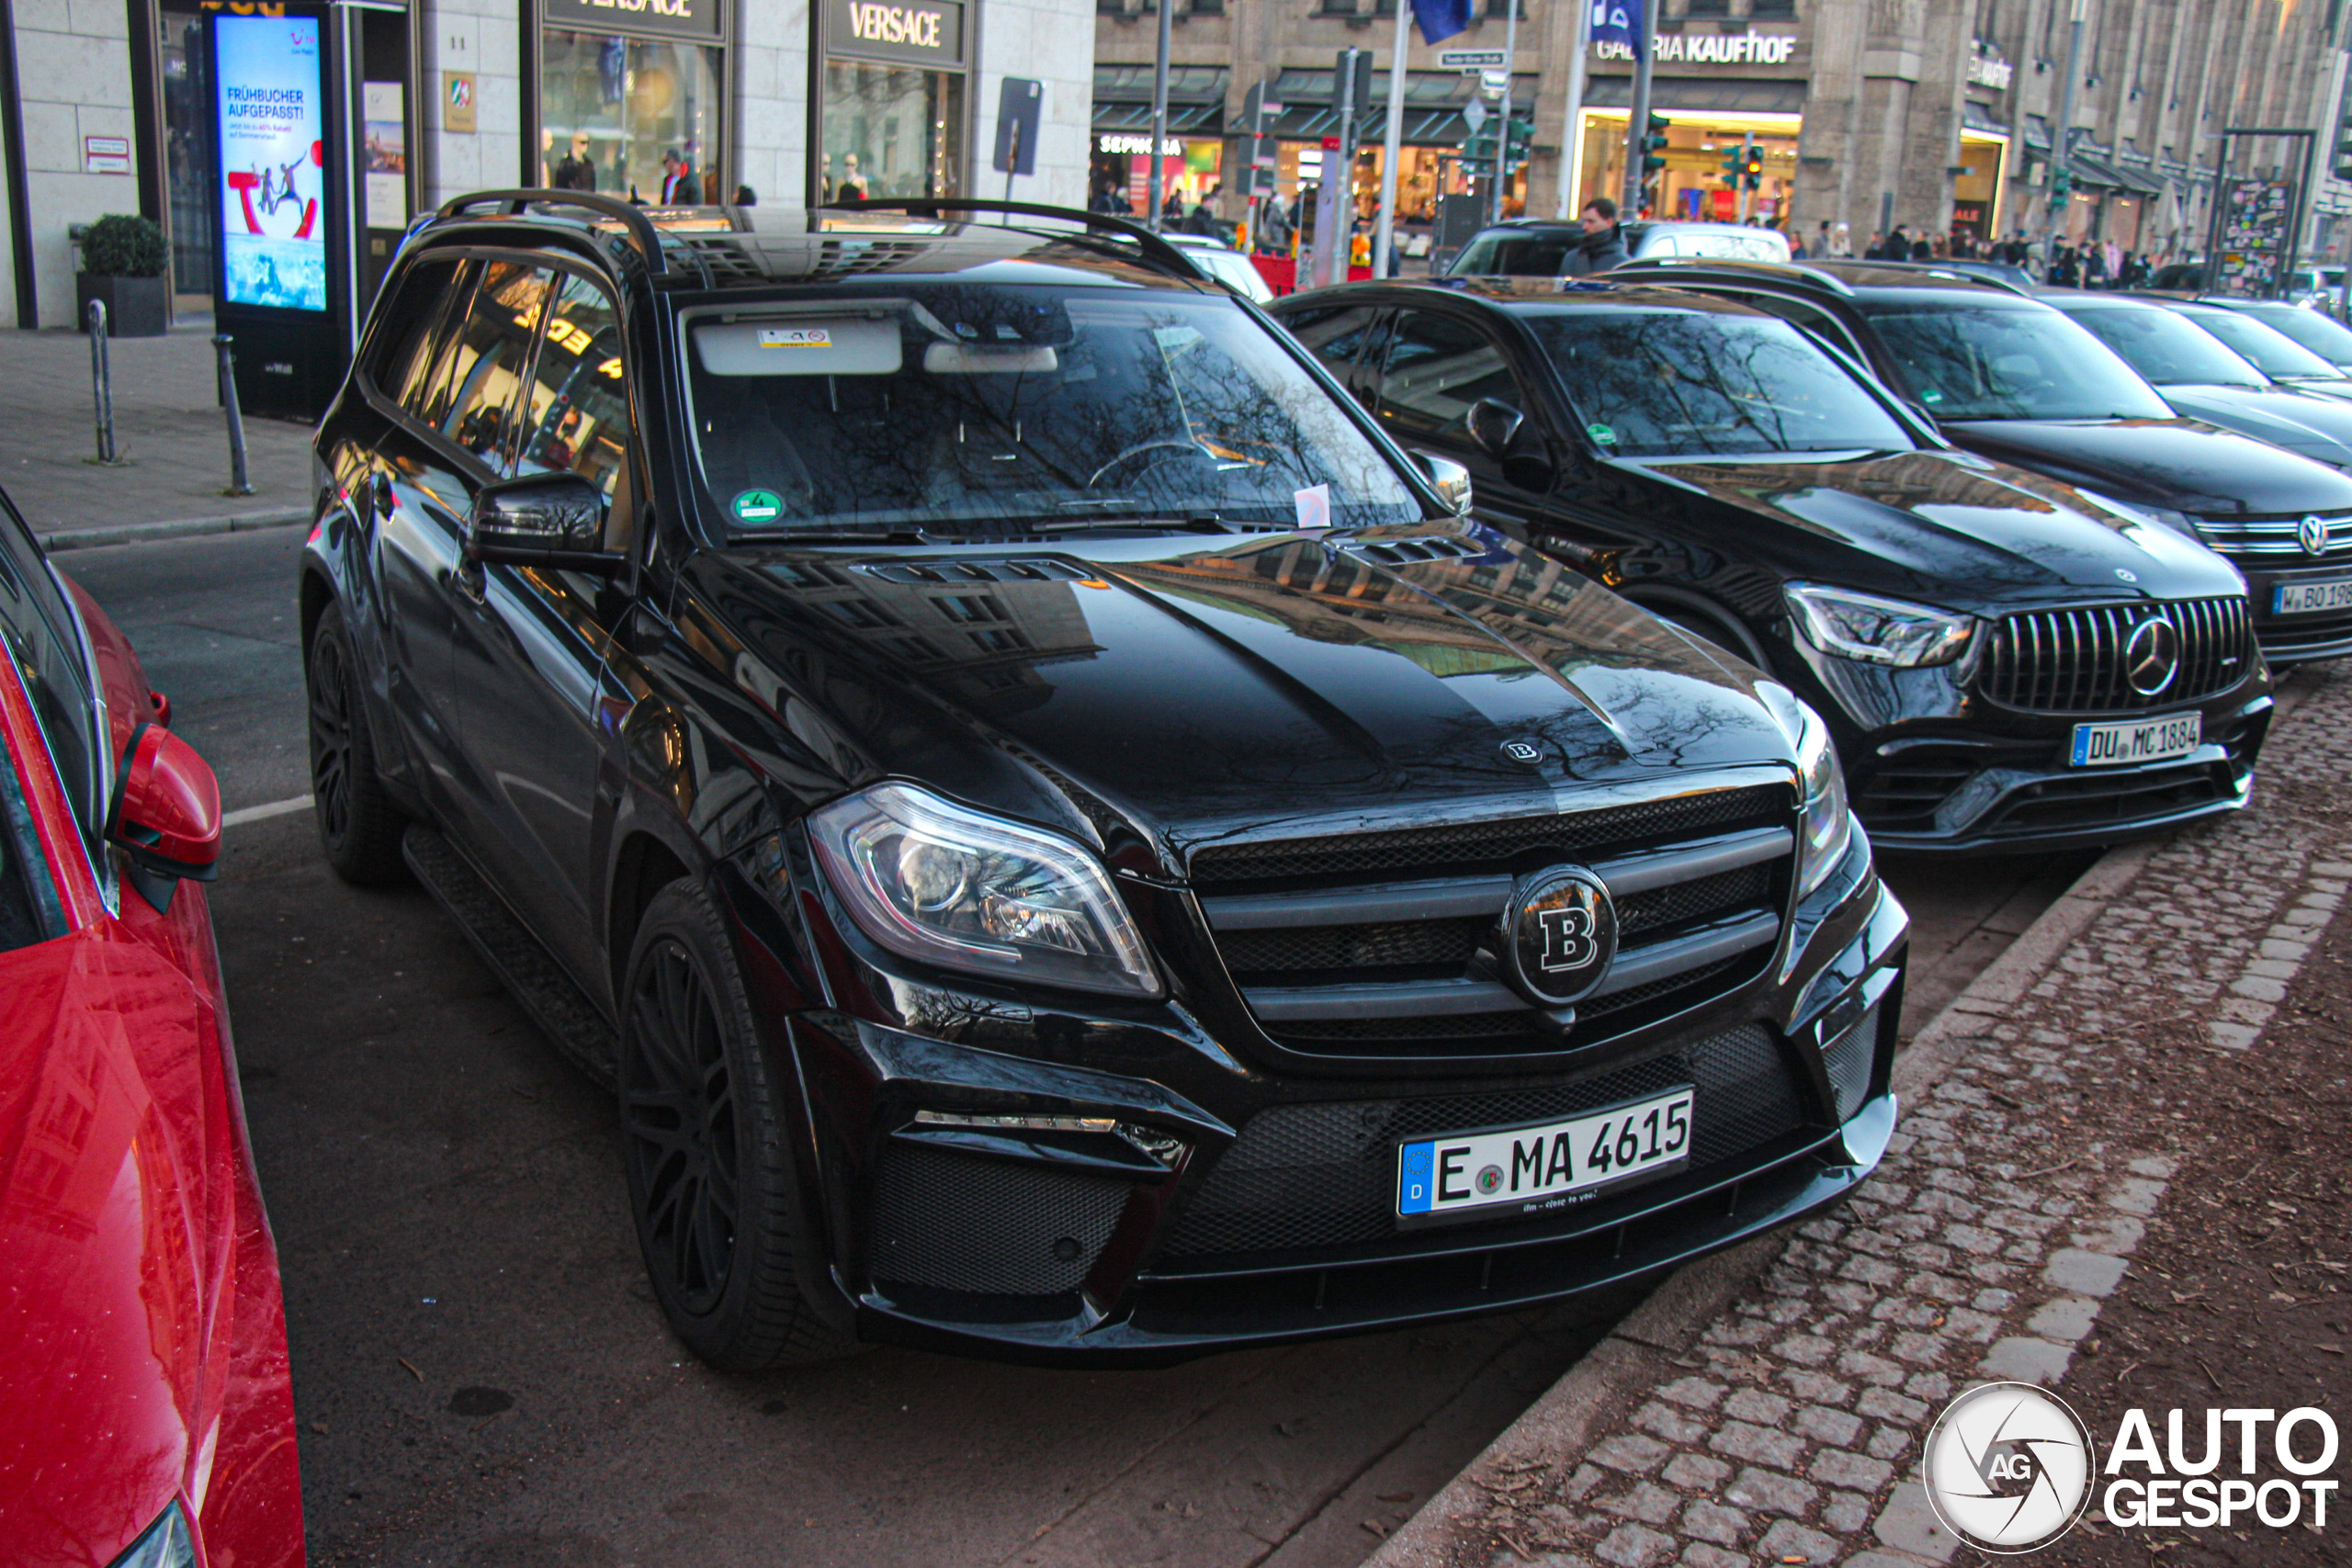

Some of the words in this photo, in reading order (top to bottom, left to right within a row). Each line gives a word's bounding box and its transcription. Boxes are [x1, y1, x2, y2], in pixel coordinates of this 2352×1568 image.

[850, 2, 942, 47] VERSACE
[1596, 34, 1684, 62] GALRIA
[227, 85, 304, 104] FRÜHBUCHER
[229, 104, 304, 119] AUFGEPASST!
[1953, 209, 1979, 220] ALE
[752, 493, 763, 506] 4
[2283, 588, 2295, 609] W
[2089, 730, 2119, 759] DU
[2132, 727, 2155, 756] MC
[2158, 720, 2197, 752] 1884
[1508, 743, 1537, 759] B
[1539, 907, 1598, 973] B
[1439, 1146, 1471, 1201] E
[1511, 1131, 1573, 1191] MA
[1588, 1099, 1690, 1173] 4615
[1411, 1184, 1422, 1200] D
[1544, 1199, 1566, 1209] close
